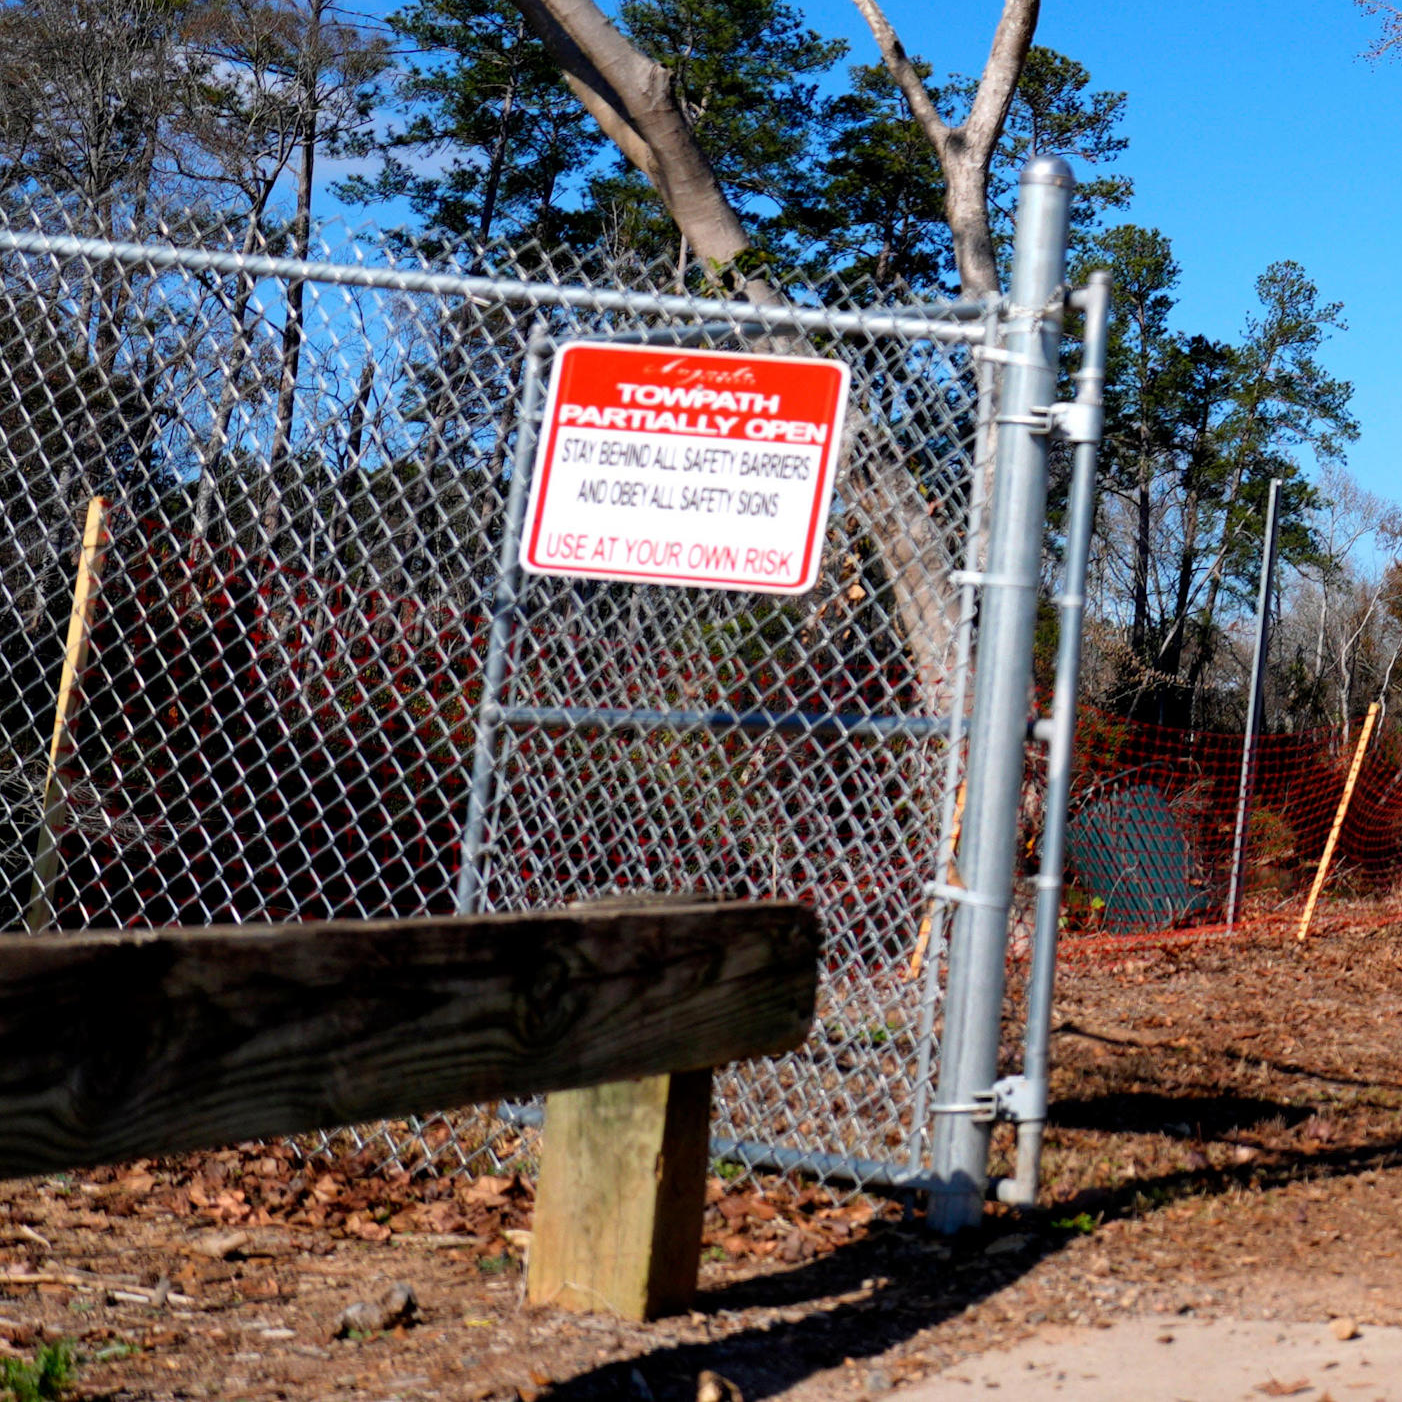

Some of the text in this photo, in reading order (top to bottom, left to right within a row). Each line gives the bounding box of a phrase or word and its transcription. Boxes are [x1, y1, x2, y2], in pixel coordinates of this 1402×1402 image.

[616, 383, 780, 414] TOWPATH
[559, 404, 828, 444] PARTIALLY OPEN
[562, 438, 810, 480] STAY BEHIND ALL SAFETY BARRIERS
[577, 479, 779, 517] AND OBEY ALL SAFETY SIGNS
[546, 532, 793, 576] USE AT YOUR OWN RISK
